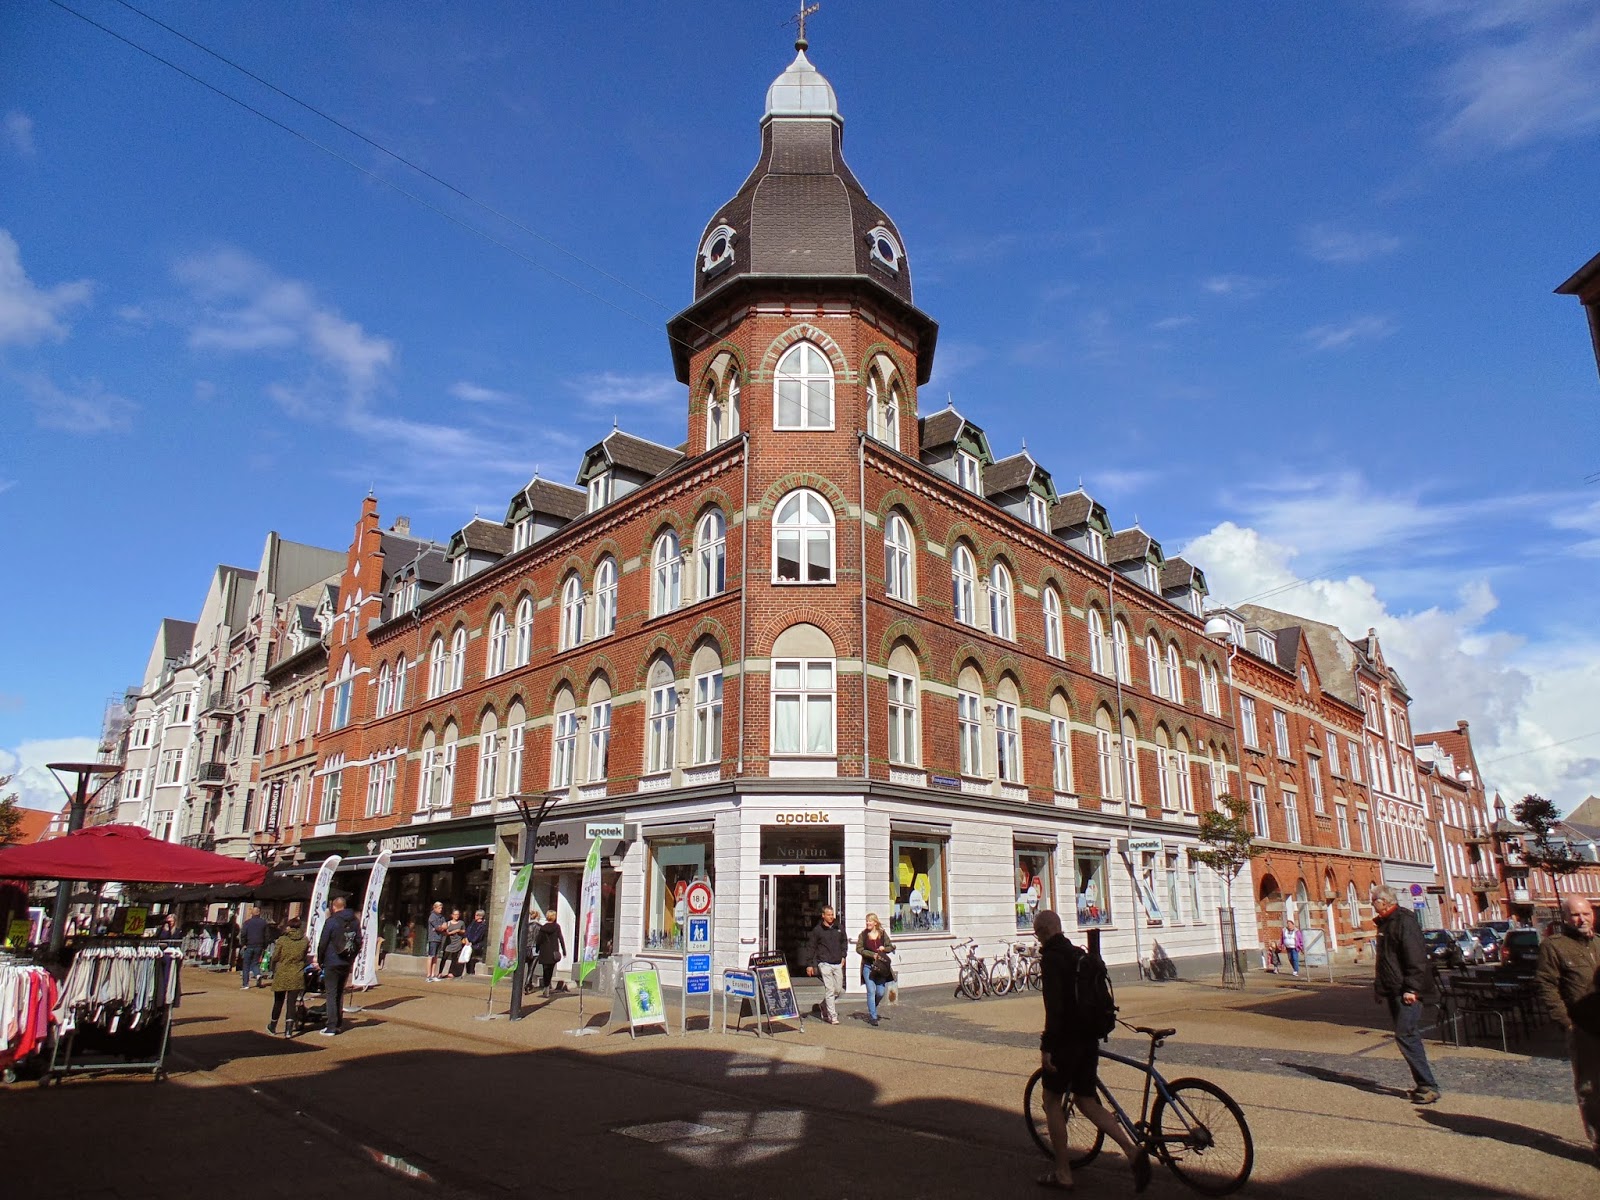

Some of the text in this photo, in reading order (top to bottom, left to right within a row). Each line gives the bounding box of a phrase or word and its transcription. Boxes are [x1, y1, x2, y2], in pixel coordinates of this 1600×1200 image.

[776, 811, 829, 825] apotek
[588, 827, 622, 837] apotek
[1129, 840, 1160, 849] apotek
[692, 895, 700, 903] 18
[732, 981, 752, 989] Ensrettet
